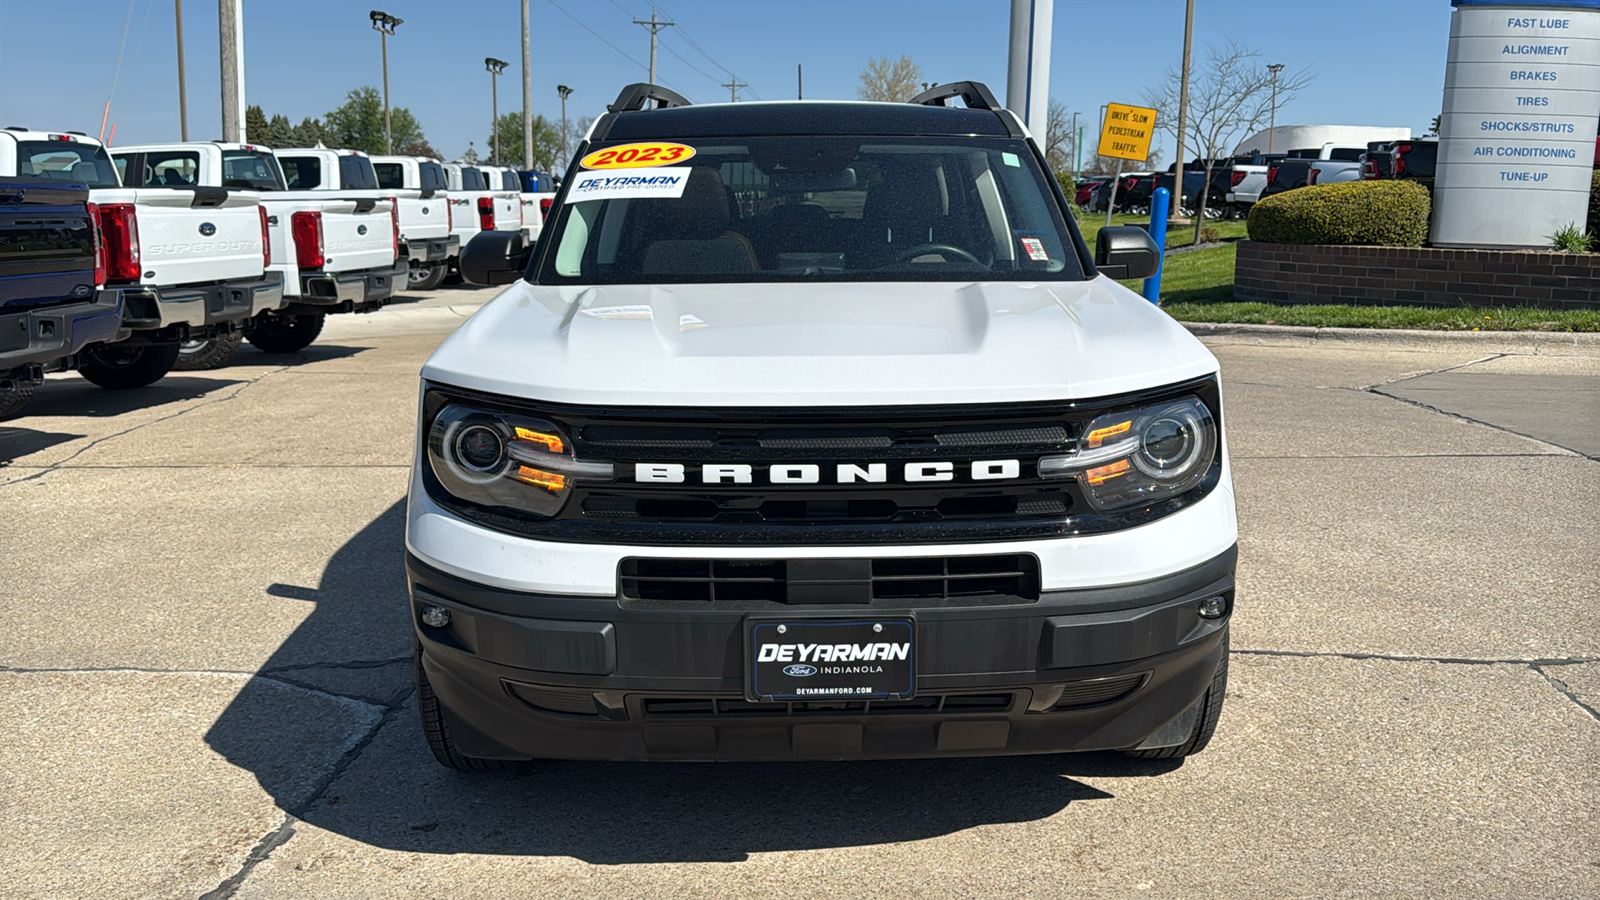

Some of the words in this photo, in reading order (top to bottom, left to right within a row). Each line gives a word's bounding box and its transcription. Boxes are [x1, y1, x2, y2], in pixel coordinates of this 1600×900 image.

[1507, 18, 1537, 28] FAST
[1539, 19, 1570, 29] LUBE
[1502, 45, 1569, 55] ALIGNMENT
[1510, 71, 1557, 81] BRAKES
[1516, 97, 1549, 106] TIRES
[1111, 111, 1129, 121] DRIVE
[1132, 113, 1148, 123] SLOW
[1108, 126, 1145, 138] PEDESTRIAN
[1480, 121, 1574, 133] SHOCKS/STRUTS
[1112, 141, 1137, 153] TRAFFIC
[1473, 146, 1493, 156] AIR
[1496, 147, 1576, 159] CONDITIONING
[591, 147, 685, 166] 2023
[578, 176, 681, 189] DEYARMAN
[1500, 171, 1549, 182] TUNE-UP
[149, 242, 216, 256] SUPER
[218, 240, 259, 252] DUTY
[328, 239, 368, 250] SUPER
[635, 459, 1020, 484] BRONCO
[757, 642, 911, 662] DEYARMAN
[820, 665, 883, 674] INDIANOLA
[796, 687, 872, 695] DEYARMANFORD.COM
